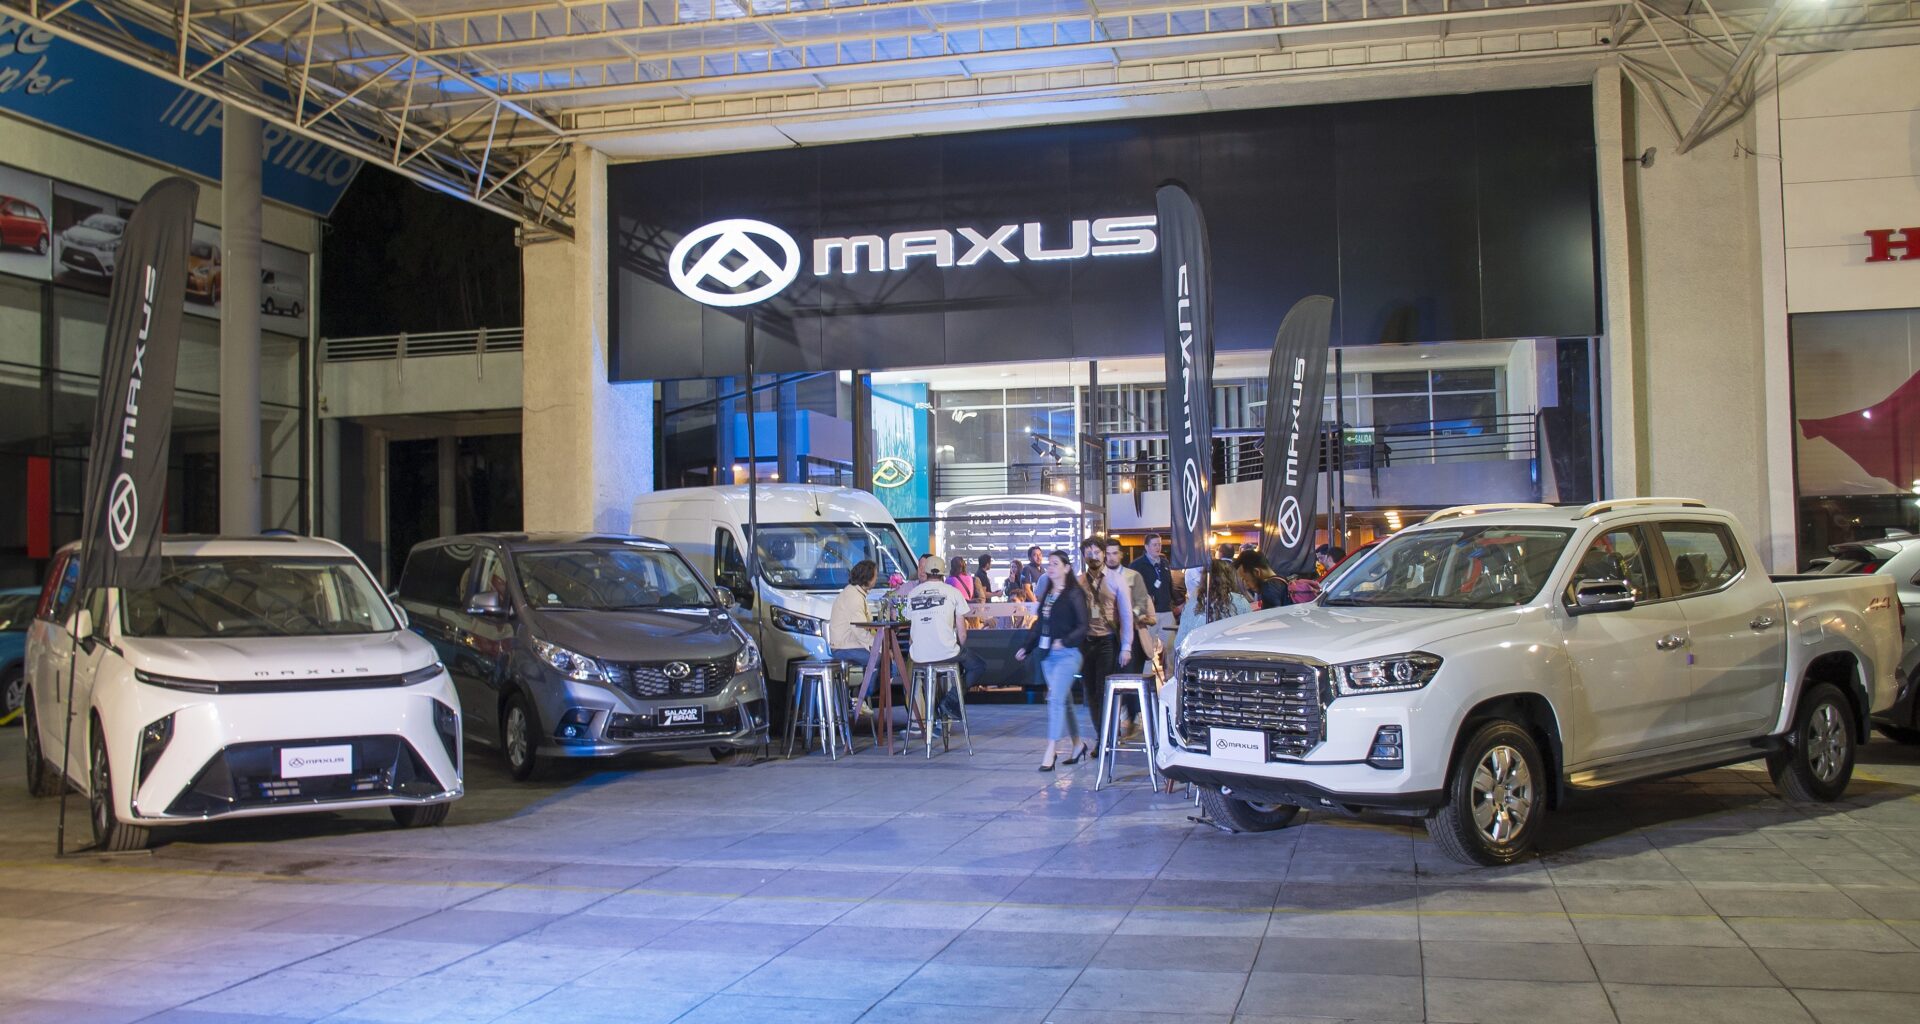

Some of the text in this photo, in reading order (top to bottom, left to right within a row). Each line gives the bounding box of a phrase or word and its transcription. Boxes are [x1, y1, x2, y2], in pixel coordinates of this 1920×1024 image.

[813, 214, 1157, 276] MAXUS
[121, 264, 156, 459] MAXUS
[1286, 357, 1305, 486] MAXUS
[1354, 433, 1372, 443] SALIDA
[254, 667, 369, 676] MAXUS
[1198, 668, 1281, 684] MAXUS
[664, 708, 698, 717] SALAZAR
[1228, 741, 1259, 750] MAXUS
[305, 757, 345, 765] MAXUS
